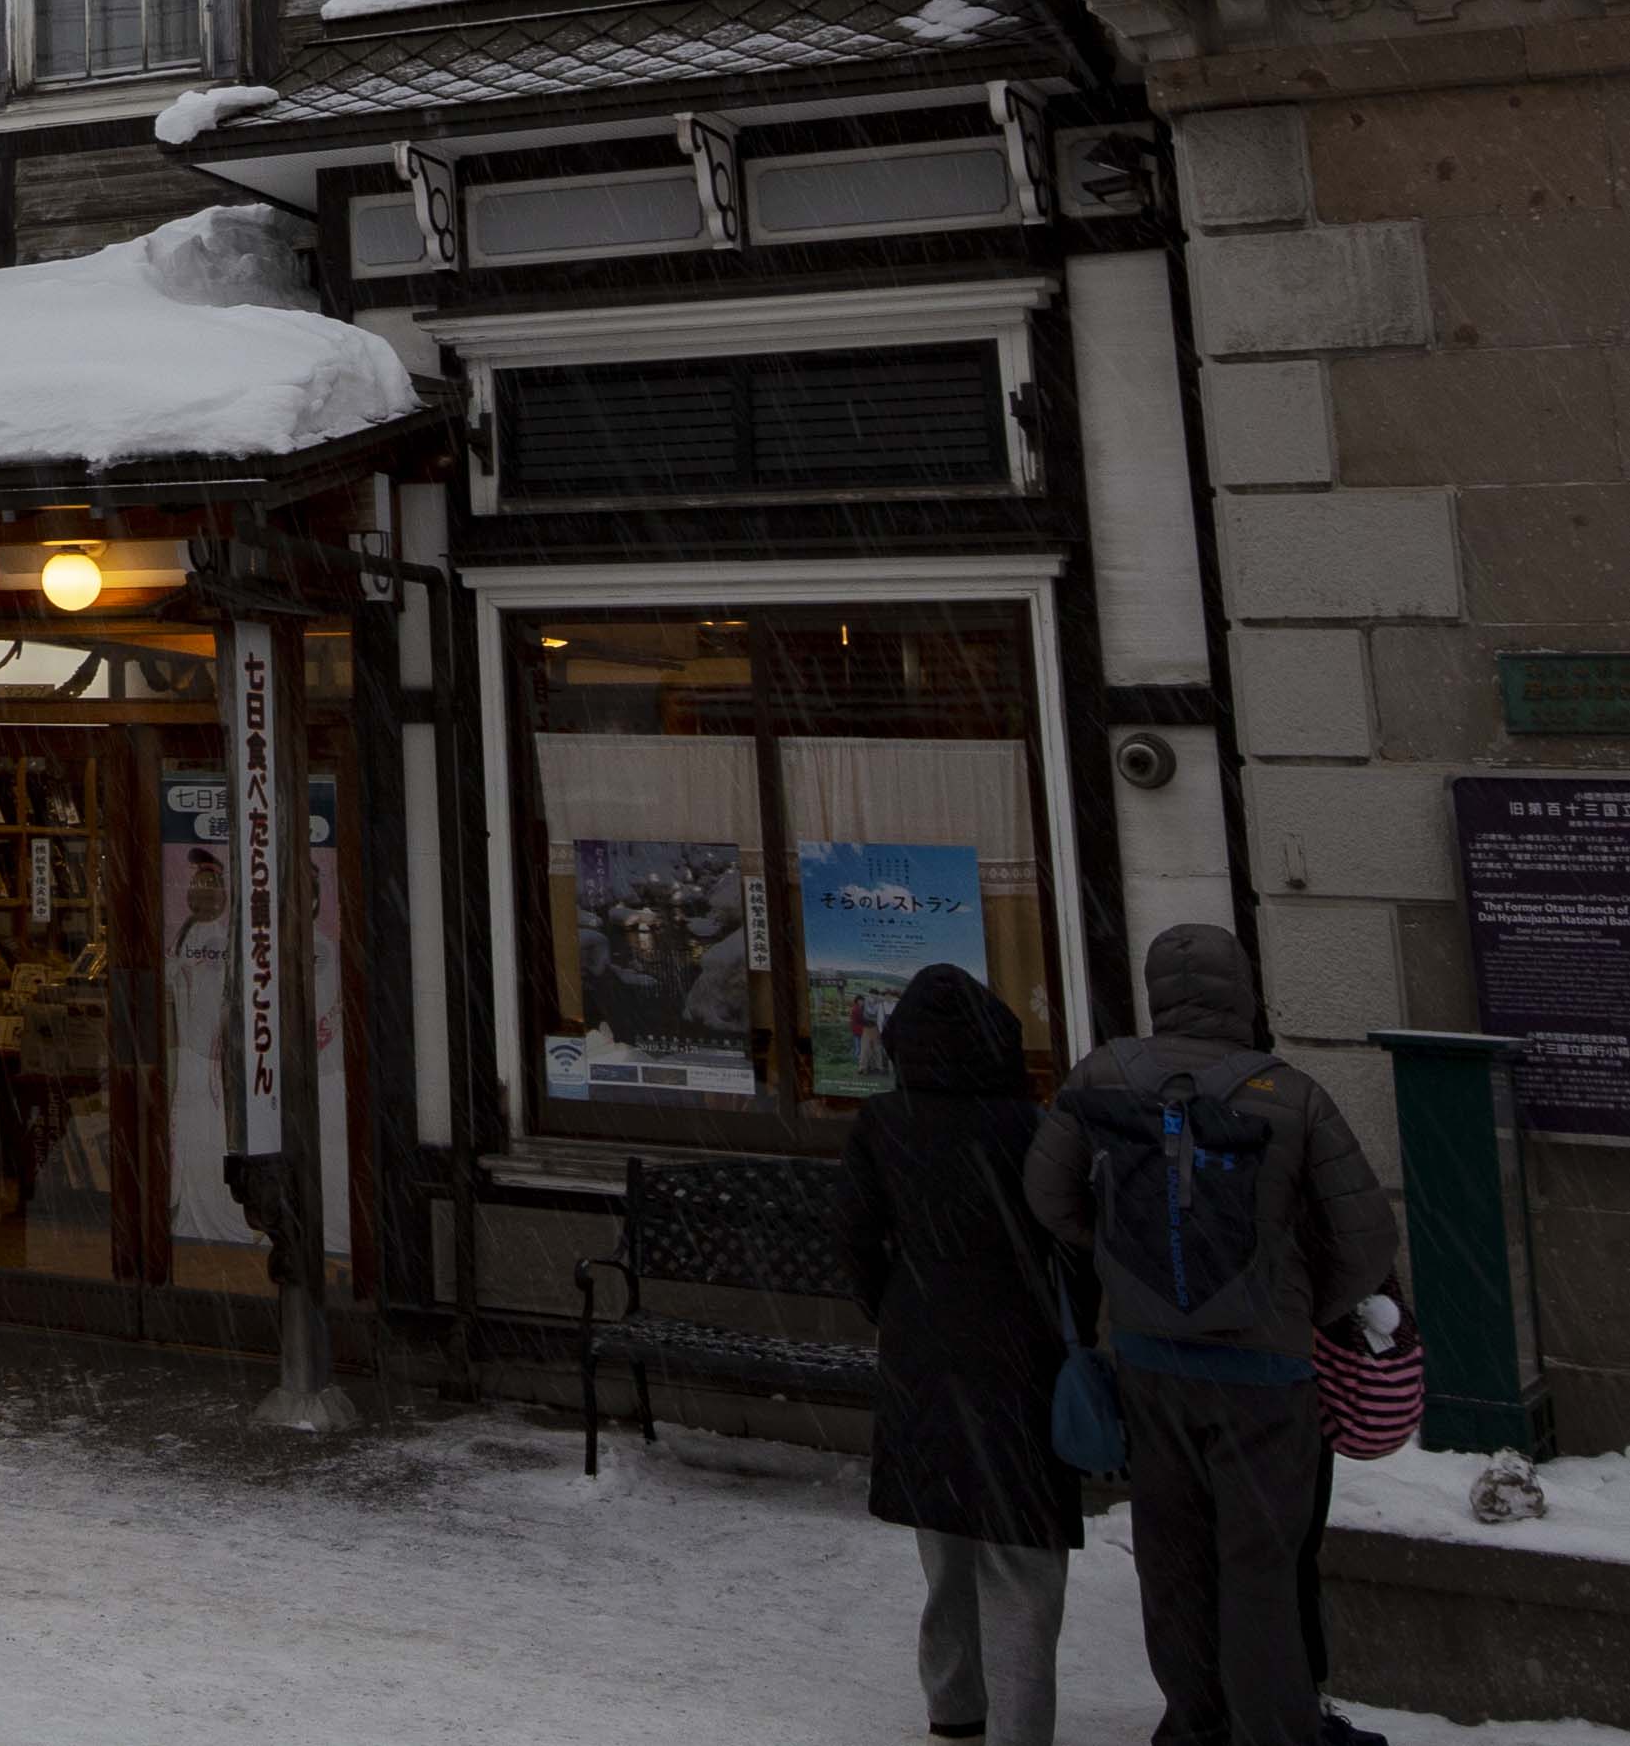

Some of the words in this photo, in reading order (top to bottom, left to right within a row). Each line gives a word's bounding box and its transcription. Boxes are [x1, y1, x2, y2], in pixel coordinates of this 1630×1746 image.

[820, 892, 962, 913] そらのレストラン
[1484, 901, 1503, 912] The
[1505, 902, 1542, 913] Former
[1545, 903, 1575, 914] Otaru
[1577, 904, 1615, 915] Branch
[1617, 905, 1629, 915] of
[1478, 913, 1496, 922] Dai
[1562, 914, 1607, 925] National
